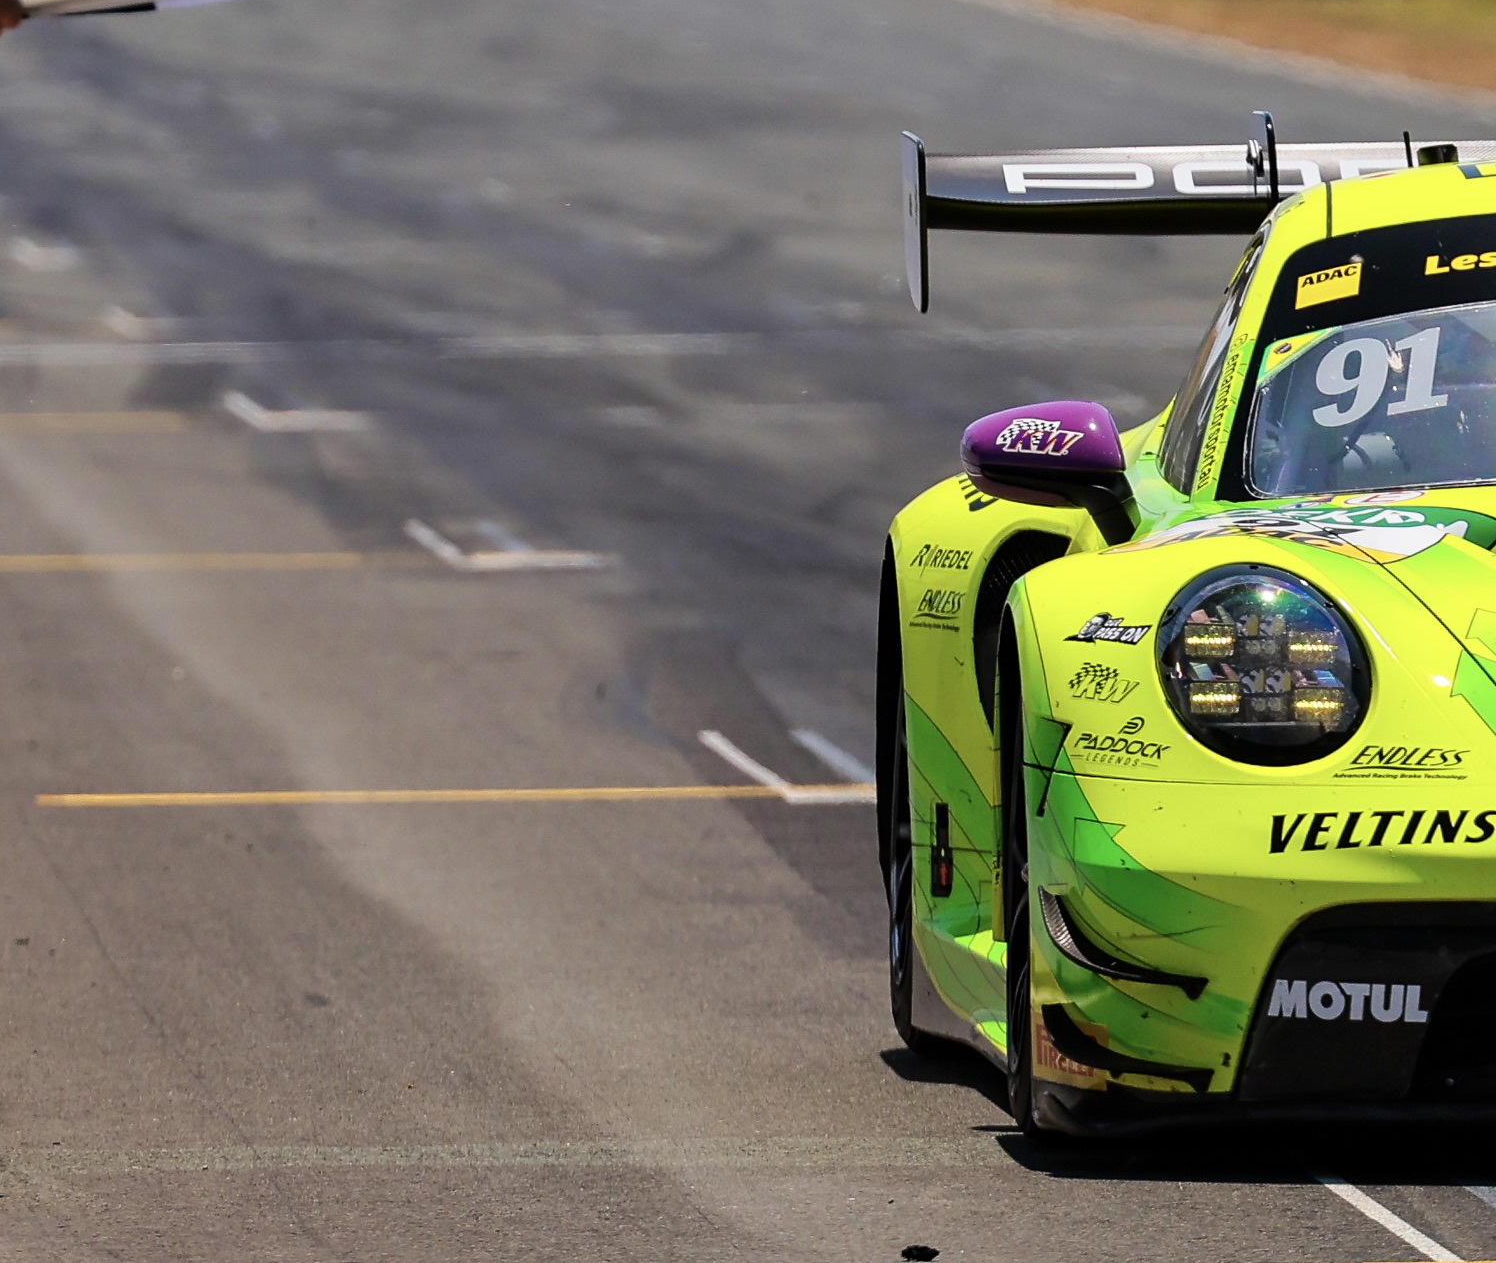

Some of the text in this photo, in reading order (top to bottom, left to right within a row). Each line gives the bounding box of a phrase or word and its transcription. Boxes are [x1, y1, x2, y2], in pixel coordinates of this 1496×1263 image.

[1301, 265, 1358, 289] ADAC
[1312, 326, 1449, 429] 91
[917, 589, 966, 615] ENDLESS
[1073, 732, 1172, 760] PADDOCK
[1349, 745, 1472, 767] ENDLESS
[1085, 751, 1141, 768] LEGENDS
[1372, 772, 1398, 780] Racing
[1423, 773, 1469, 781] Technology
[1266, 978, 1430, 1024] MOTUL
